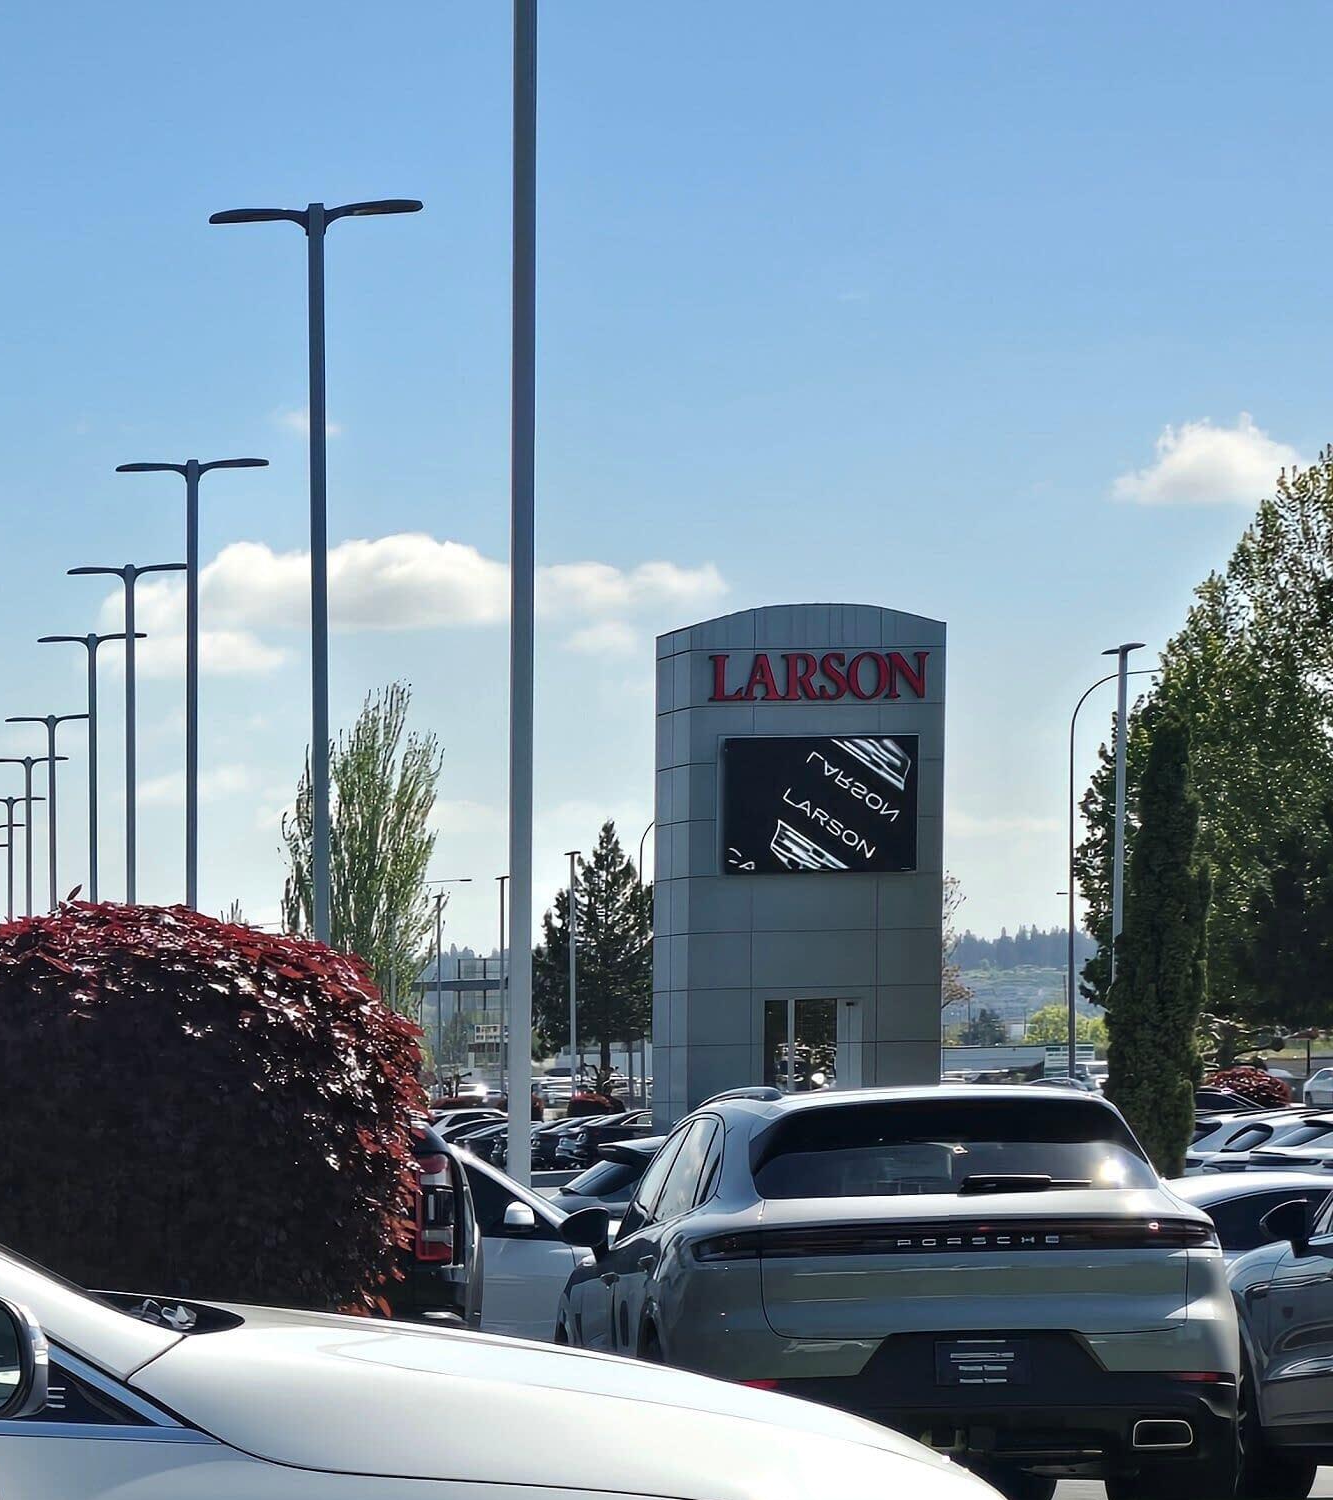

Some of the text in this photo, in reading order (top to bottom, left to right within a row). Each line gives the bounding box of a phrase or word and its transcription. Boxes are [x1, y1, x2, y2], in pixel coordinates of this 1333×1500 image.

[708, 651, 930, 702] LARSON
[782, 787, 876, 859] LARSON
[897, 1235, 1060, 1246] PORSCHE
